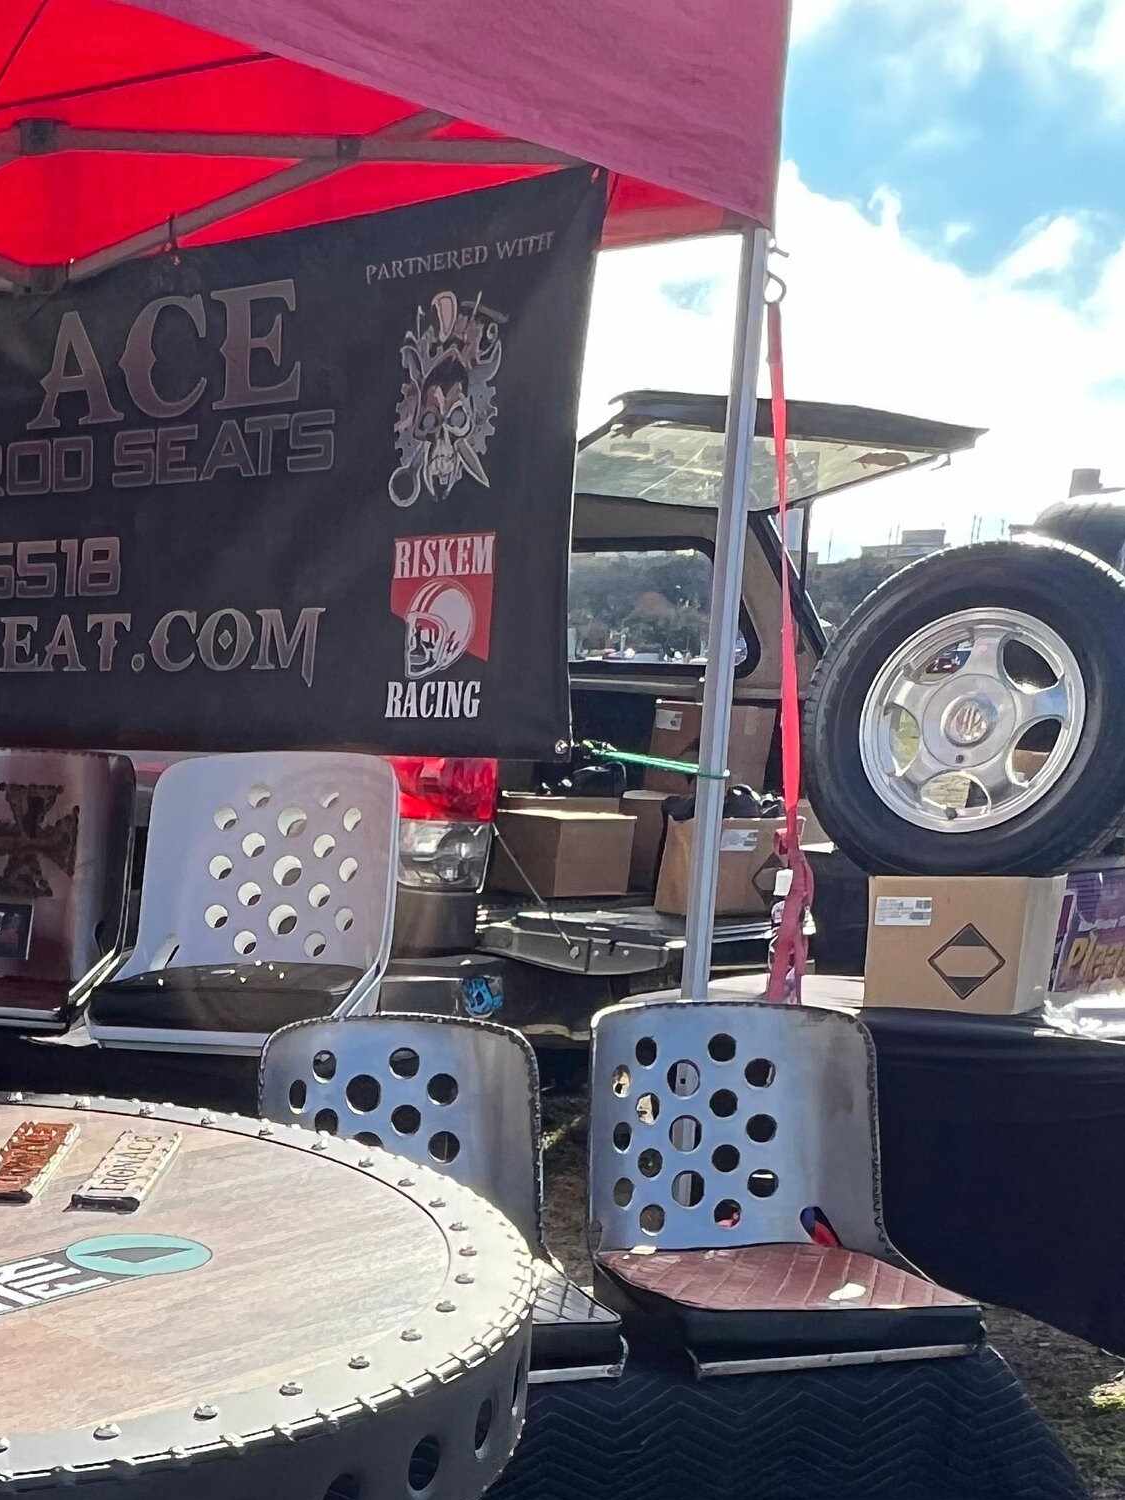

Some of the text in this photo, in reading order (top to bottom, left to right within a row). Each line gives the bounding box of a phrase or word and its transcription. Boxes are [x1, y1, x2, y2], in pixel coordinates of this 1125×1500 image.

[366, 231, 555, 285] PARTNERED WITH
[26, 279, 301, 430] ACE
[112, 410, 336, 487] SEATS
[394, 536, 495, 579] RISKEM
[384, 681, 481, 718] RACING
[1059, 930, 1125, 988] Plea
